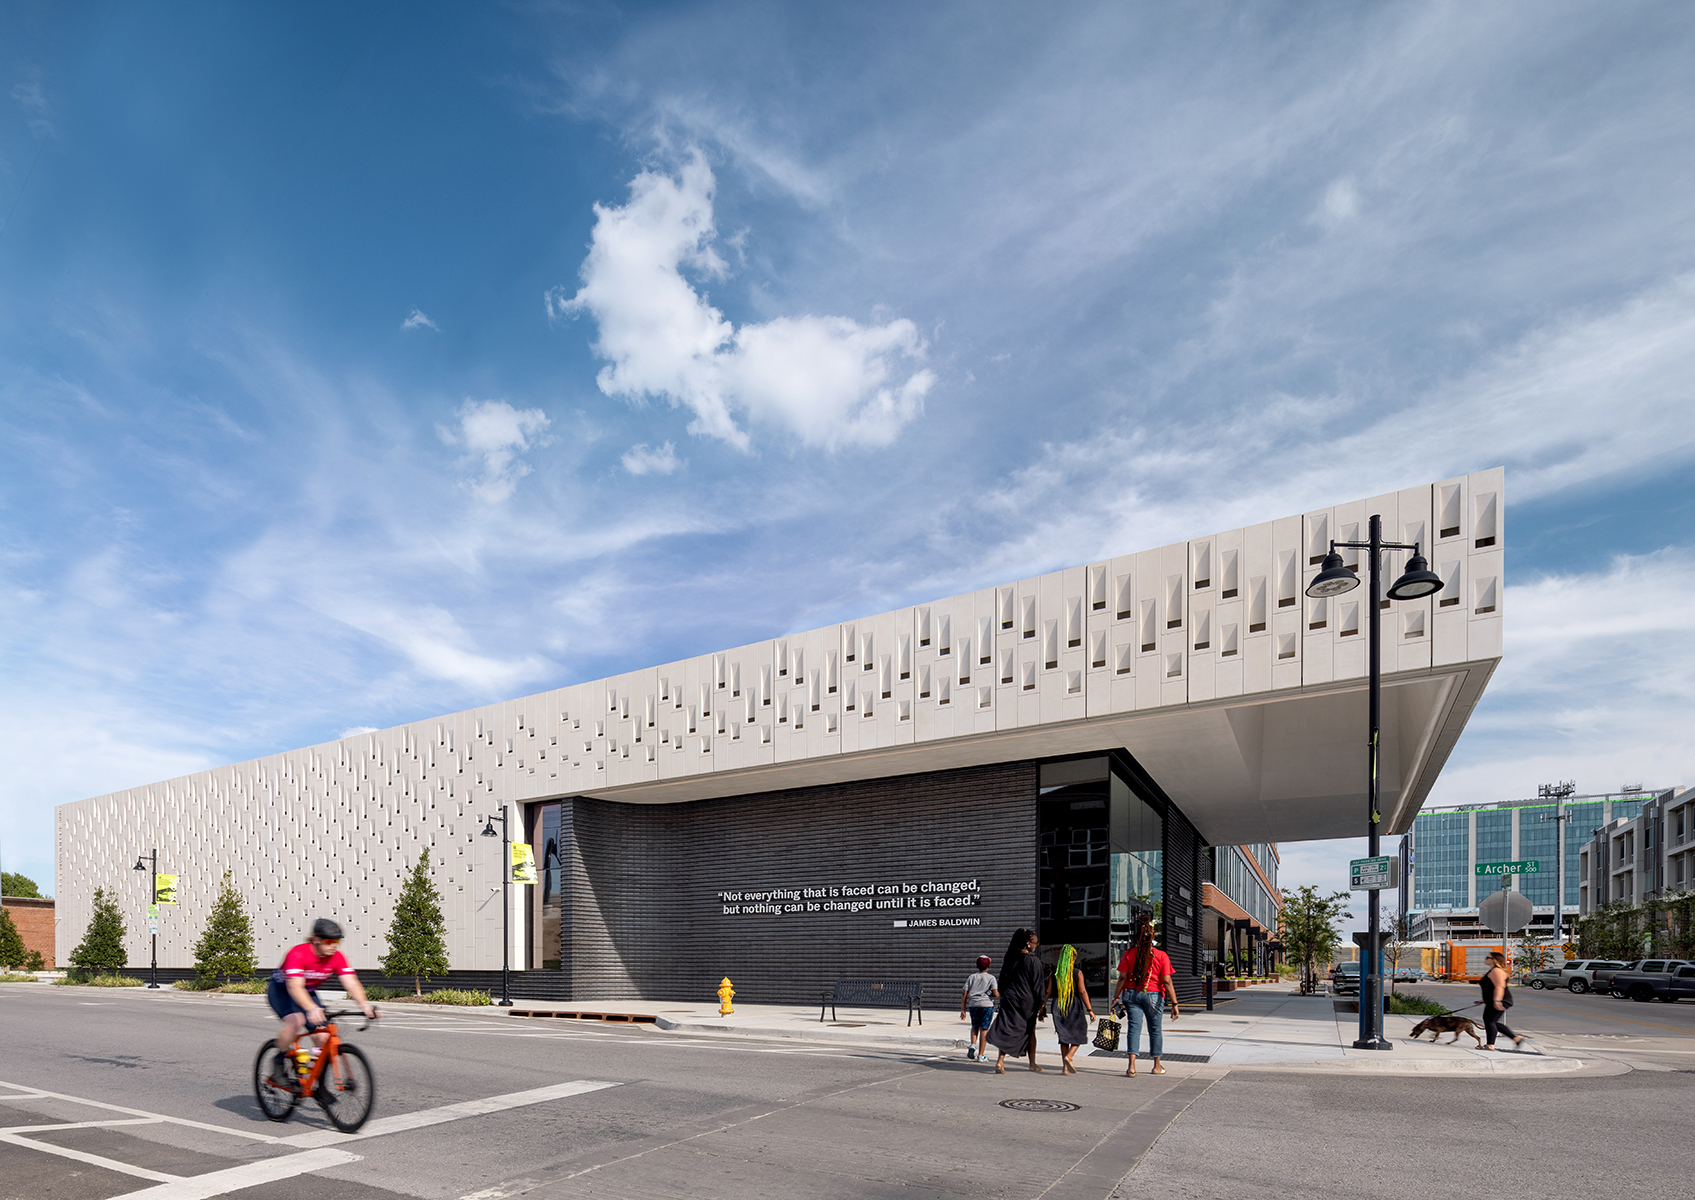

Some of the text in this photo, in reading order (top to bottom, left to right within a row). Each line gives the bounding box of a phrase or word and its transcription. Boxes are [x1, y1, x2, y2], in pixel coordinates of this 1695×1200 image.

[1484, 864, 1522, 874] Archer
[744, 889, 800, 902] everything
[804, 887, 826, 898] that
[830, 886, 839, 897] is
[842, 884, 874, 896] faced
[877, 885, 899, 895] can
[902, 882, 918, 894] be
[920, 879, 981, 893] changed,
[723, 904, 740, 914] but
[742, 902, 782, 915] nothing
[784, 904, 804, 912] can
[807, 900, 820, 912] be
[824, 899, 872, 912] changed
[876, 898, 904, 910] until
[907, 897, 917, 908] it
[920, 896, 931, 908] is
[908, 918, 980, 928] JAMES BALDWIN
